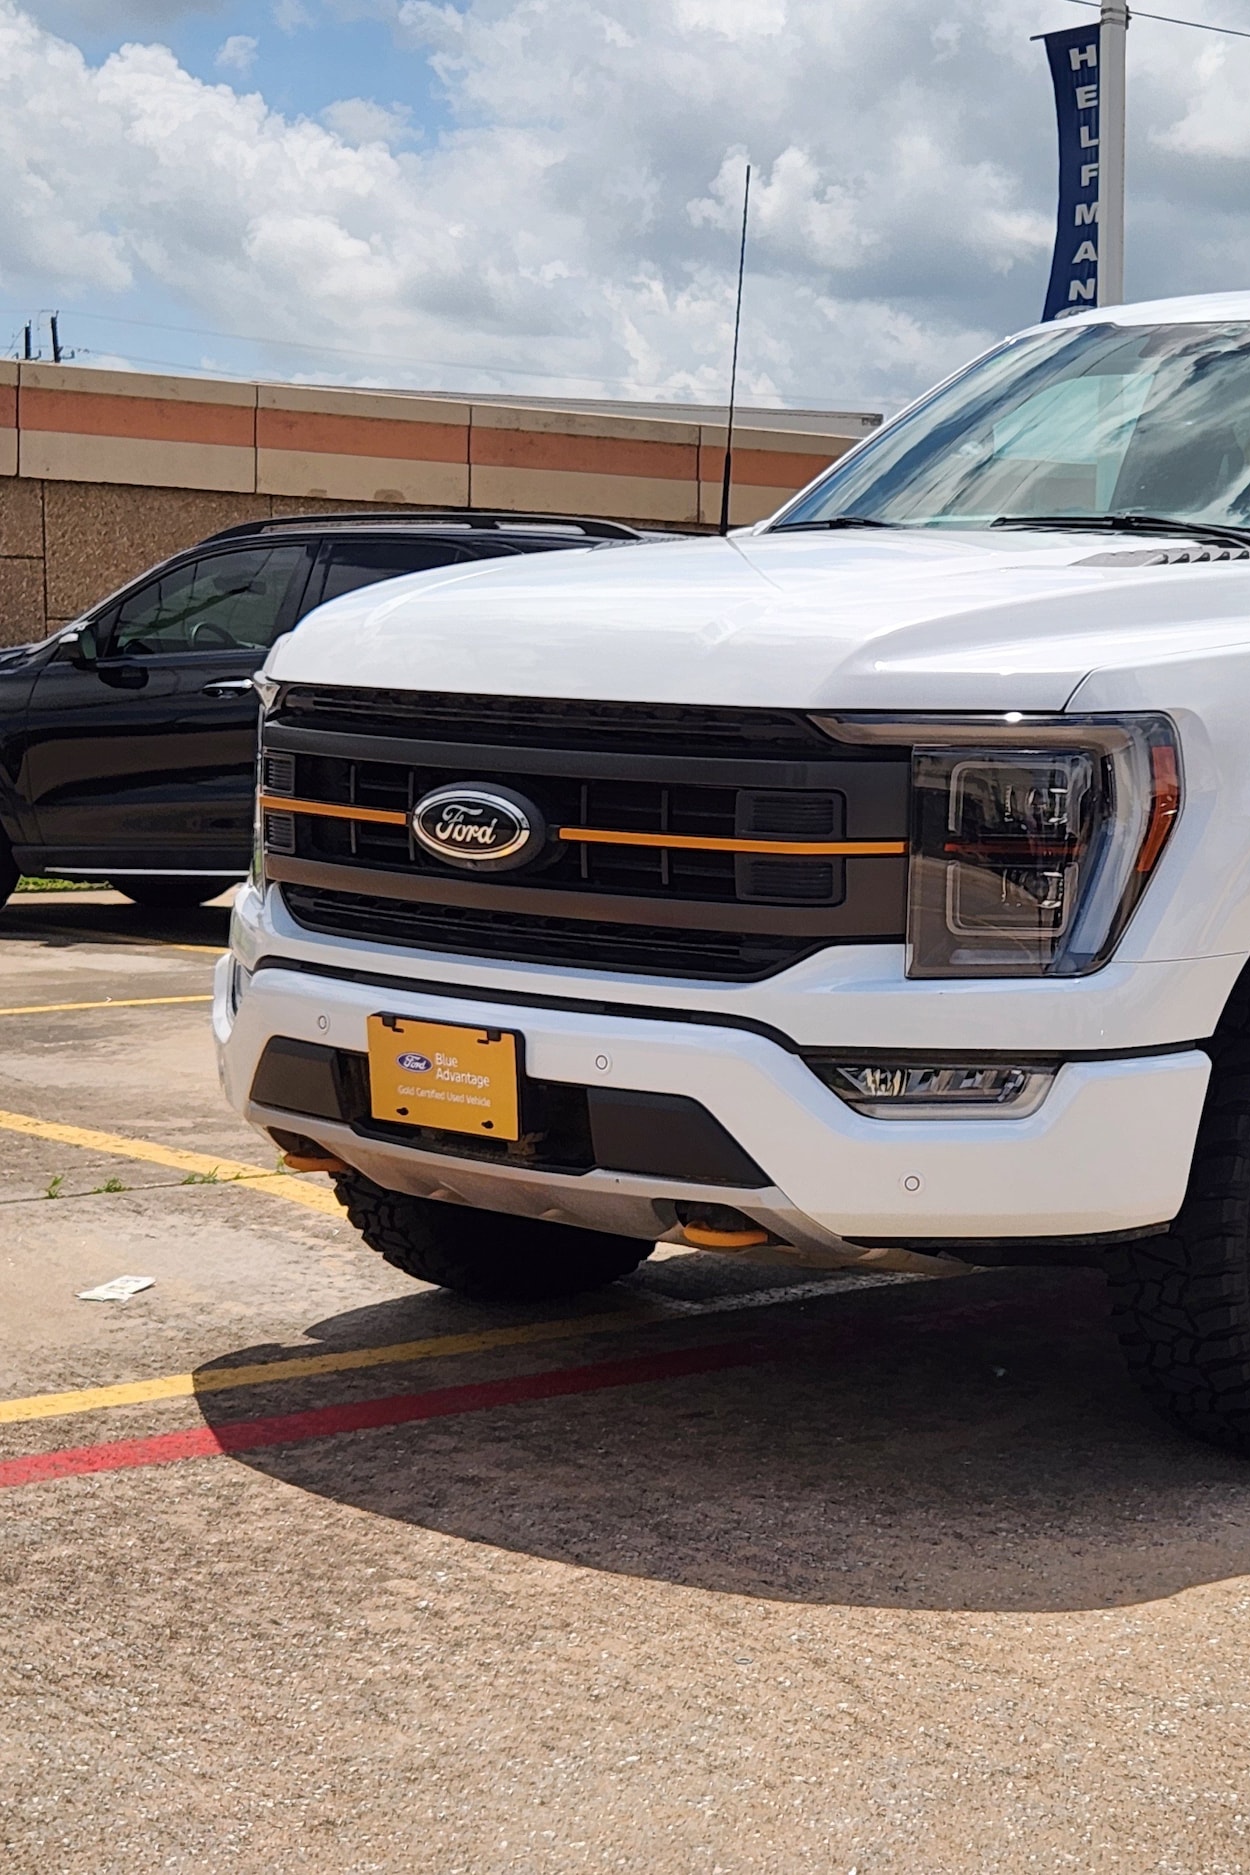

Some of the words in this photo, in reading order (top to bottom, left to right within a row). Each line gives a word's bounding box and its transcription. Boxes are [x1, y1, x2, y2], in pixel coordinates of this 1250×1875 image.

[1068, 44, 1099, 301] HELFMAN
[435, 804, 498, 844] Ford
[435, 1053, 458, 1067] Blue
[436, 1069, 490, 1088] Advantage
[398, 1085, 415, 1096] Gold
[416, 1087, 445, 1100] Certified
[447, 1093, 465, 1104] Used
[466, 1095, 491, 1107] Vehicle
